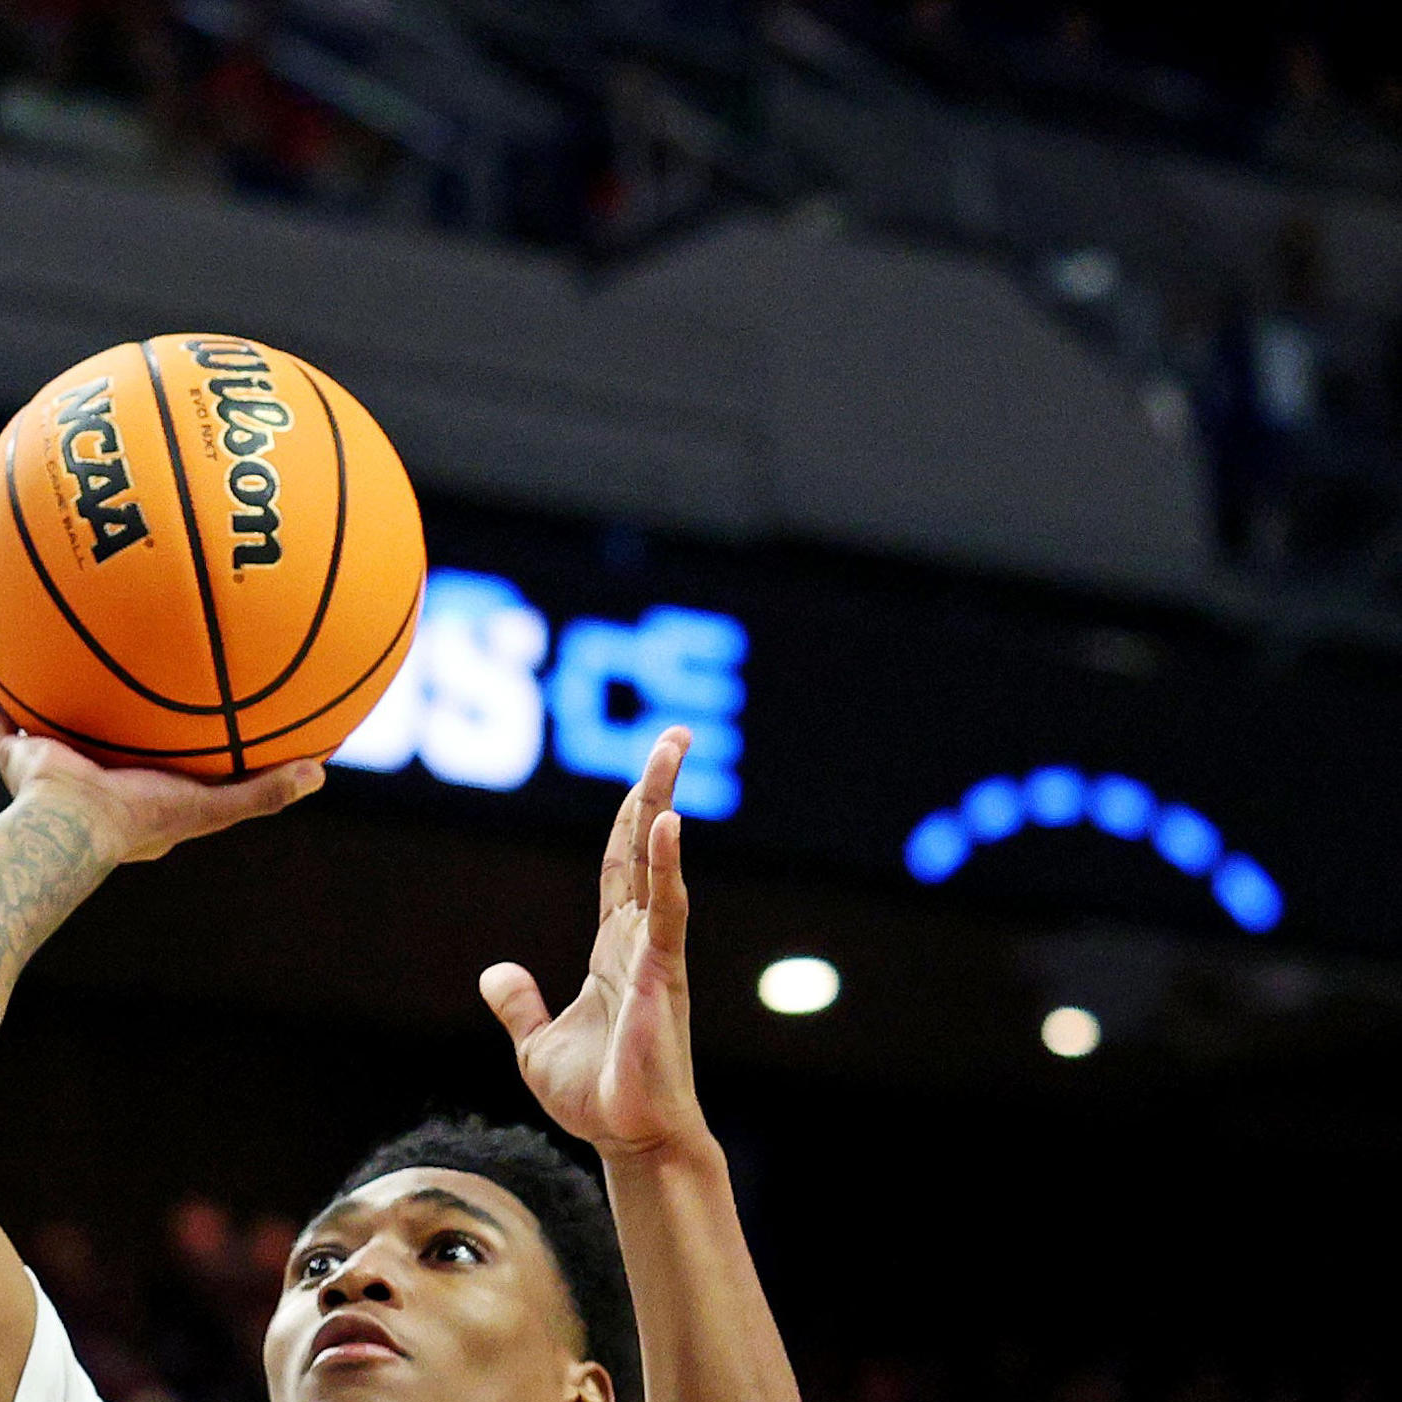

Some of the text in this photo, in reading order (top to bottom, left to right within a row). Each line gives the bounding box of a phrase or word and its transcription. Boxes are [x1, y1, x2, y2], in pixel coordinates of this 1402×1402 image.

[54, 375, 150, 564] NCAA
[180, 338, 295, 571] Wilson
[190, 388, 208, 419] EVO
